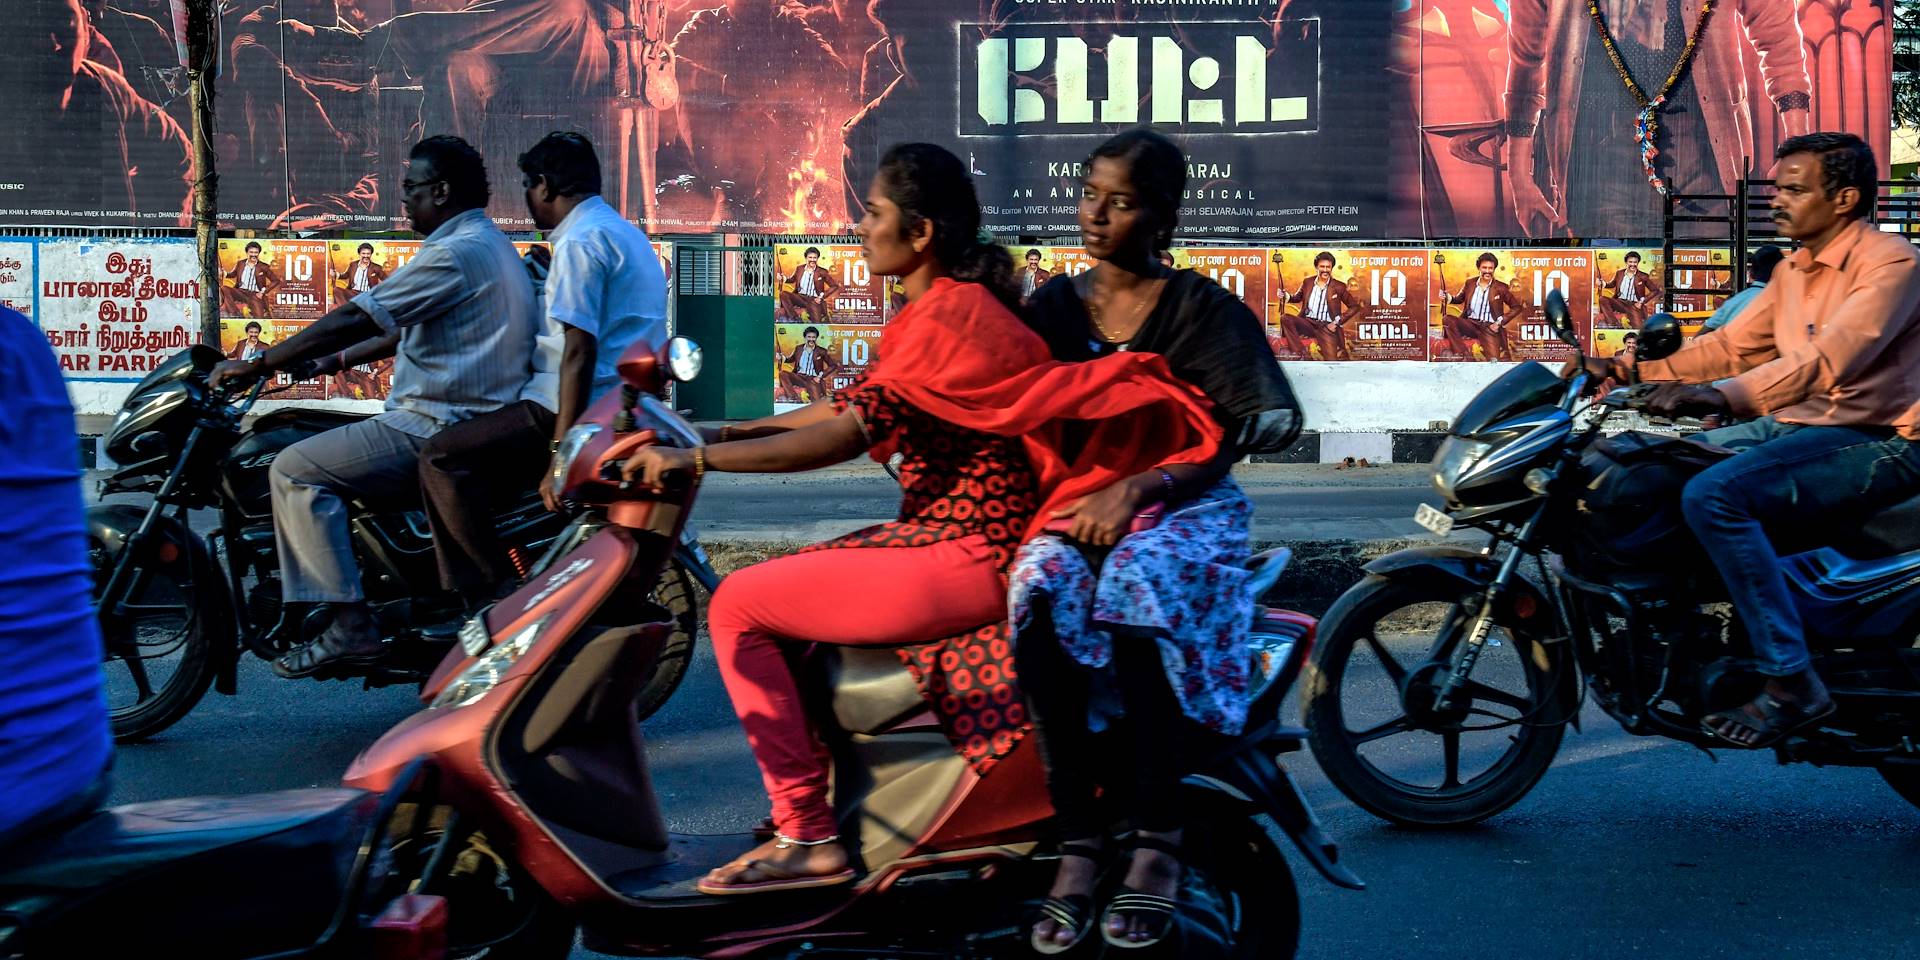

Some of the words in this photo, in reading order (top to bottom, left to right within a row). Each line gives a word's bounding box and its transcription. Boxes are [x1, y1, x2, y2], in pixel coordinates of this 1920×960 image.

[1186, 163, 1231, 179] ARAJ
[1013, 189, 1033, 198] AN
[1050, 187, 1085, 198] ANI
[1183, 190, 1255, 200] USICAL
[1024, 206, 1049, 214] VIVEK
[1052, 206, 1081, 214] HARSH
[1199, 207, 1253, 216] SELVARAJAN
[1278, 208, 1305, 216] DIRECTOR
[1307, 206, 1336, 214] PETER
[1338, 206, 1359, 215] HEIN
[1245, 226, 1280, 234] JAGADEESH
[1286, 224, 1316, 232] GOWTHAM
[285, 254, 313, 281] 10
[844, 259, 870, 287] 10
[1370, 269, 1407, 306] 10
[98, 300, 148, 324] இடம்
[842, 338, 869, 366] 10
[58, 354, 90, 371] AR
[98, 354, 163, 372] PARK
